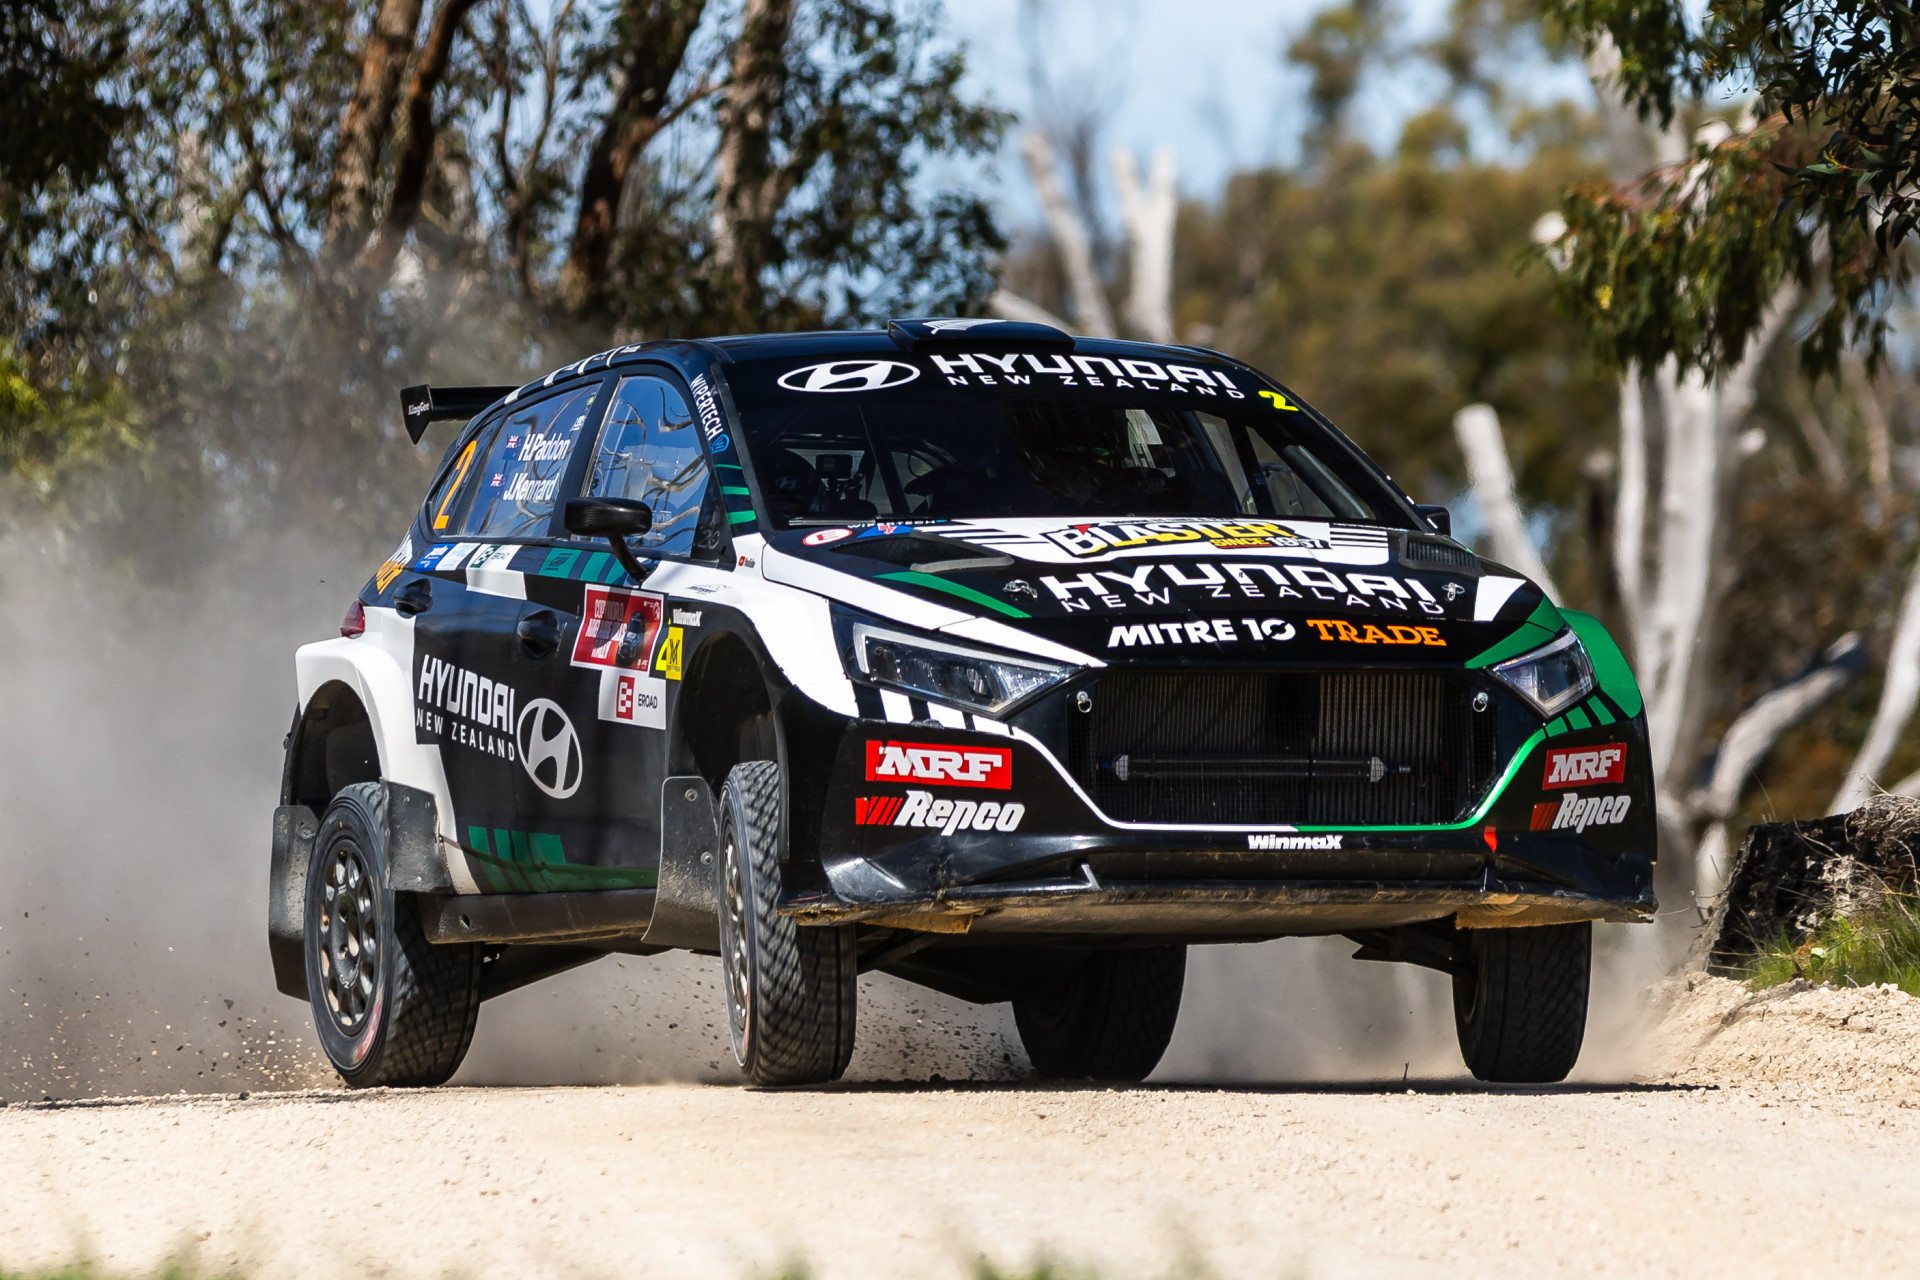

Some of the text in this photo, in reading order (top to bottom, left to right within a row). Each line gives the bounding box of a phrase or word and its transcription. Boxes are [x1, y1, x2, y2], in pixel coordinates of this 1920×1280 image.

[929, 353, 1238, 390] HYUNDAI
[947, 375, 1245, 399] NEW ZEALAND
[690, 373, 724, 441] WIPERTECH
[1258, 390, 1299, 412] 2
[518, 433, 571, 461] H.Paddon
[503, 472, 560, 501] J.Kennard
[1046, 521, 1299, 556] BLASTER
[1210, 538, 1270, 546] SINCE
[1039, 563, 1437, 606] HYUNDAI
[1060, 584, 1444, 614] NEW ZEALAND
[1107, 618, 1448, 648] MITRE 10 TRADE
[417, 654, 516, 735] HYUNDAI
[638, 693, 659, 710] EROAD
[416, 708, 515, 763] NEW ZEALAND
[876, 747, 1003, 783] MRF
[1547, 749, 1621, 784] MRF
[893, 789, 1027, 837] Repco
[1551, 792, 1632, 834] Repco
